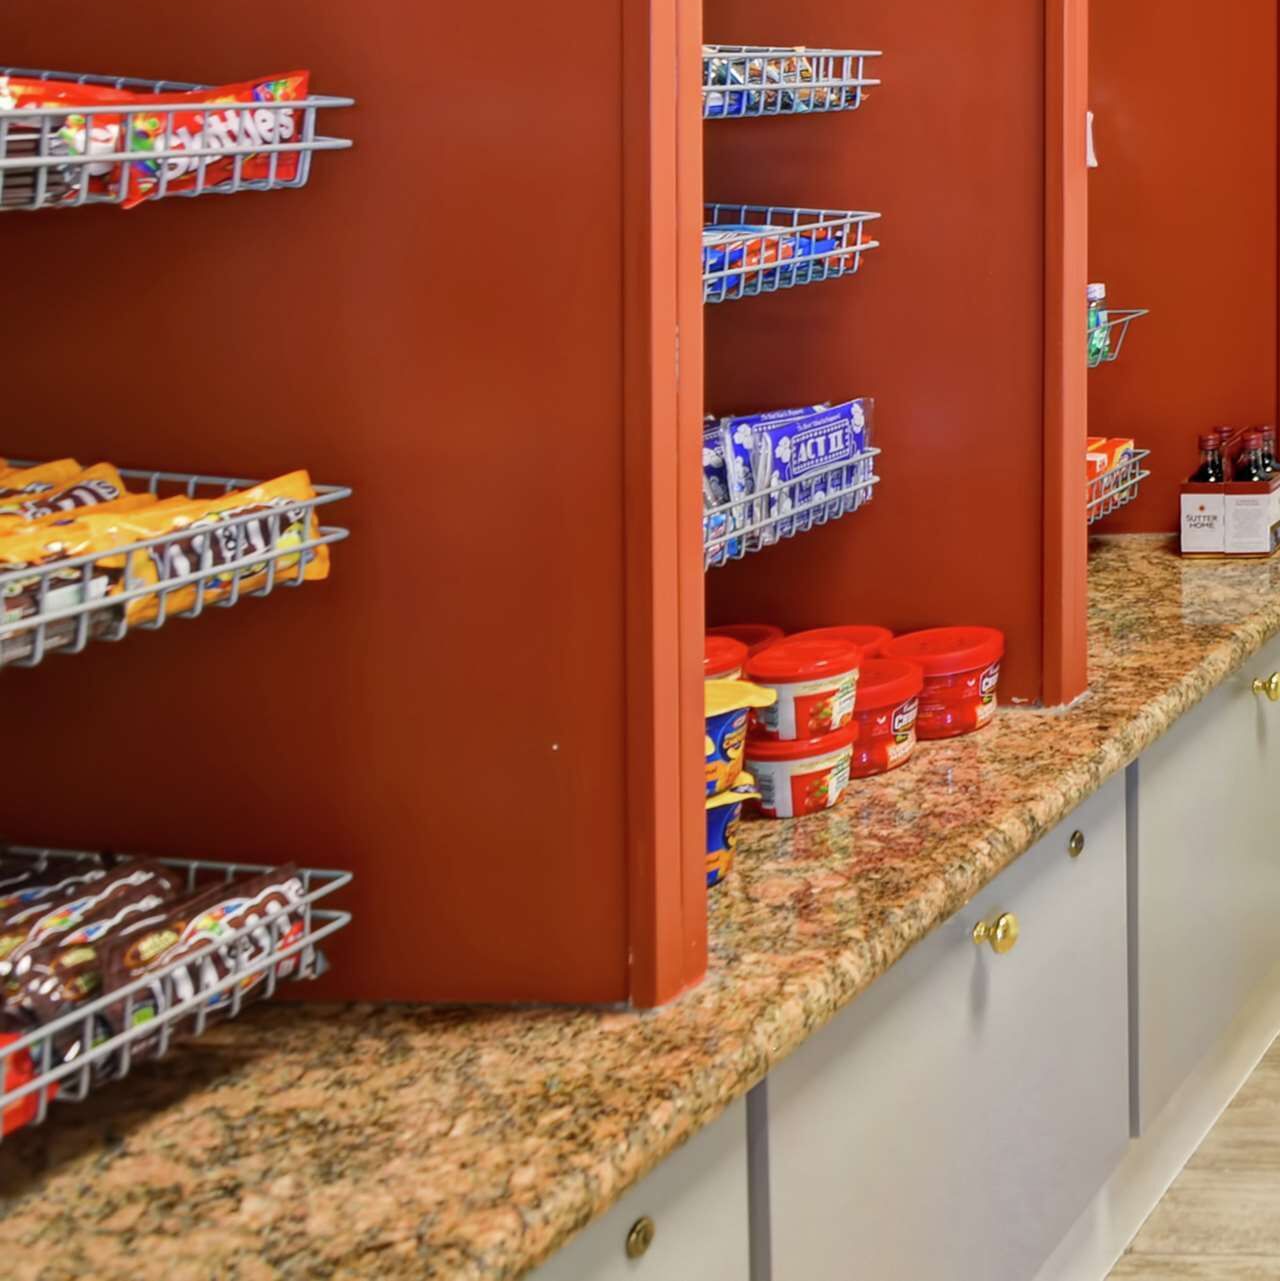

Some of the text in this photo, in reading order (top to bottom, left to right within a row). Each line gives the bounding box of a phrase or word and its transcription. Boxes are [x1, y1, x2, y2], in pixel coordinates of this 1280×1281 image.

[798, 435, 827, 463] ACT
[1185, 514, 1218, 522] SUTTER
[1189, 522, 1215, 530] HOME
